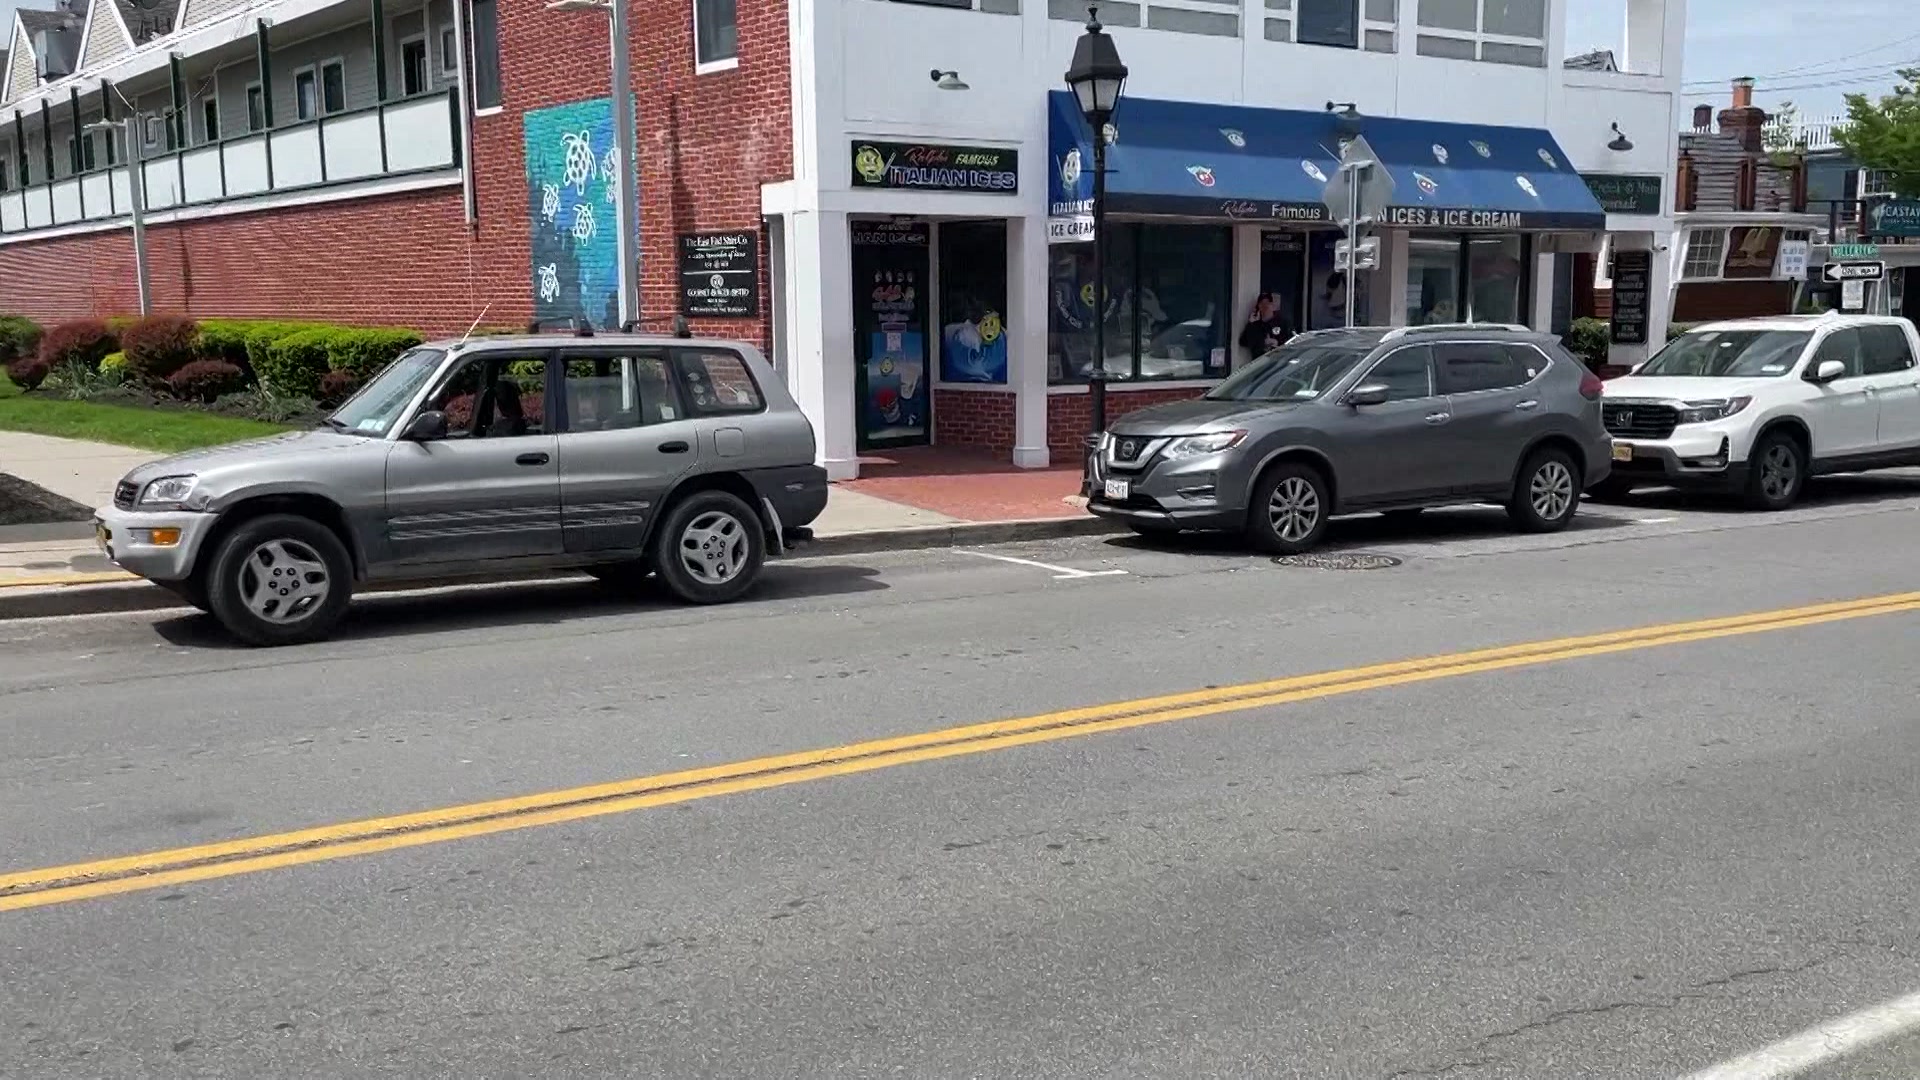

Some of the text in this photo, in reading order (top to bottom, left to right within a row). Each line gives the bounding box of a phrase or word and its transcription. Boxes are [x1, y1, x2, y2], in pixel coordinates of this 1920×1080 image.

[955, 153, 1000, 166] FAMOUS
[889, 165, 1016, 189] ITALIAN ICES
[1271, 204, 1321, 219] Famous
[1392, 208, 1426, 225] ICES
[1430, 210, 1440, 225] &
[1444, 210, 1469, 226] ICE
[1471, 211, 1522, 227] CREAM
[1051, 223, 1065, 237] ICE
